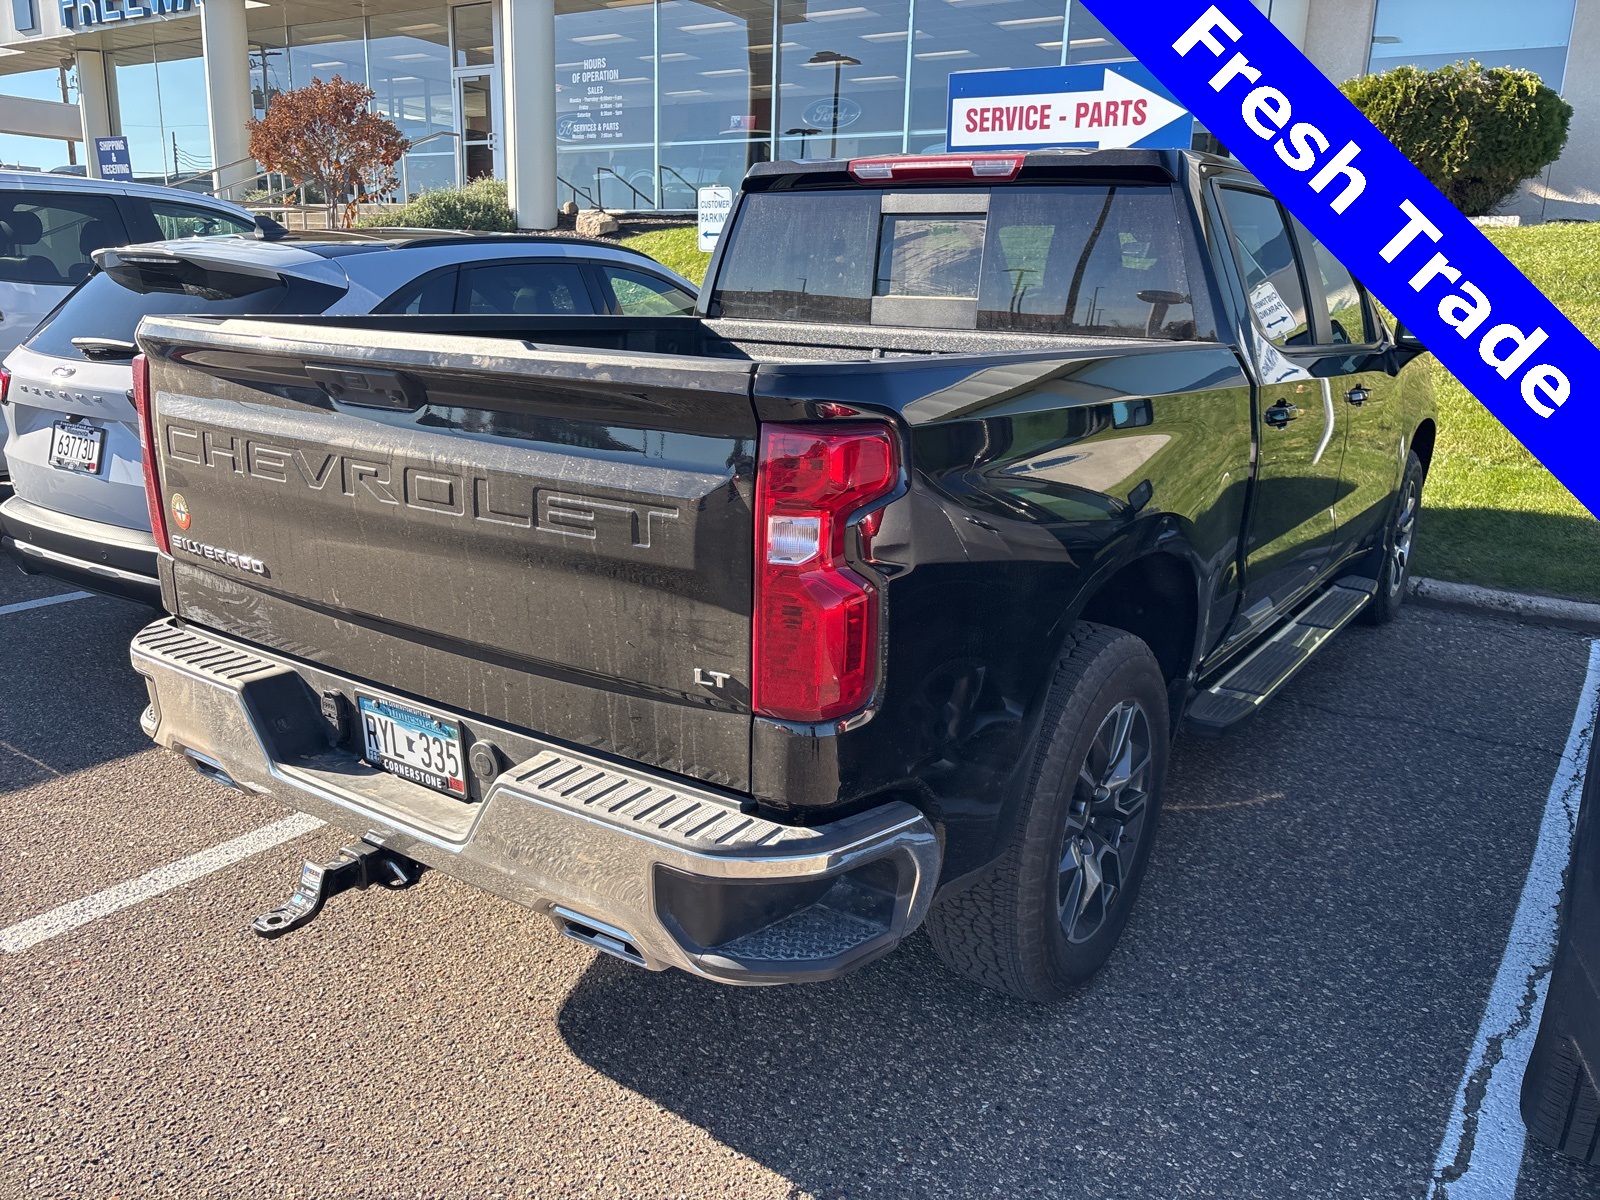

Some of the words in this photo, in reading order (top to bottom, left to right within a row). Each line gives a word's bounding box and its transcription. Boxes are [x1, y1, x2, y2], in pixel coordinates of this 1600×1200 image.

[583, 57, 606, 70] HOURS
[572, 73, 580, 83] OF
[582, 69, 618, 82] OPERATION
[587, 86, 603, 95] SALES
[965, 105, 1050, 134] SERVICE
[1074, 98, 1148, 130] PARTS
[573, 123, 597, 133] SERVICES
[598, 123, 602, 131] &
[603, 122, 619, 131] PARTS
[99, 141, 124, 151] SHIPPING
[111, 152, 117, 163] &
[102, 164, 129, 174] RECEIVING
[700, 200, 730, 209] CUSTOMER
[57, 434, 95, 461] 63773D
[166, 424, 681, 549] CHEVROLET
[171, 534, 266, 575] SILVERADO
[694, 667, 731, 689] LT
[365, 713, 405, 760] RYL
[418, 732, 459, 778] 335
[383, 758, 442, 789] CORNERSTONE
